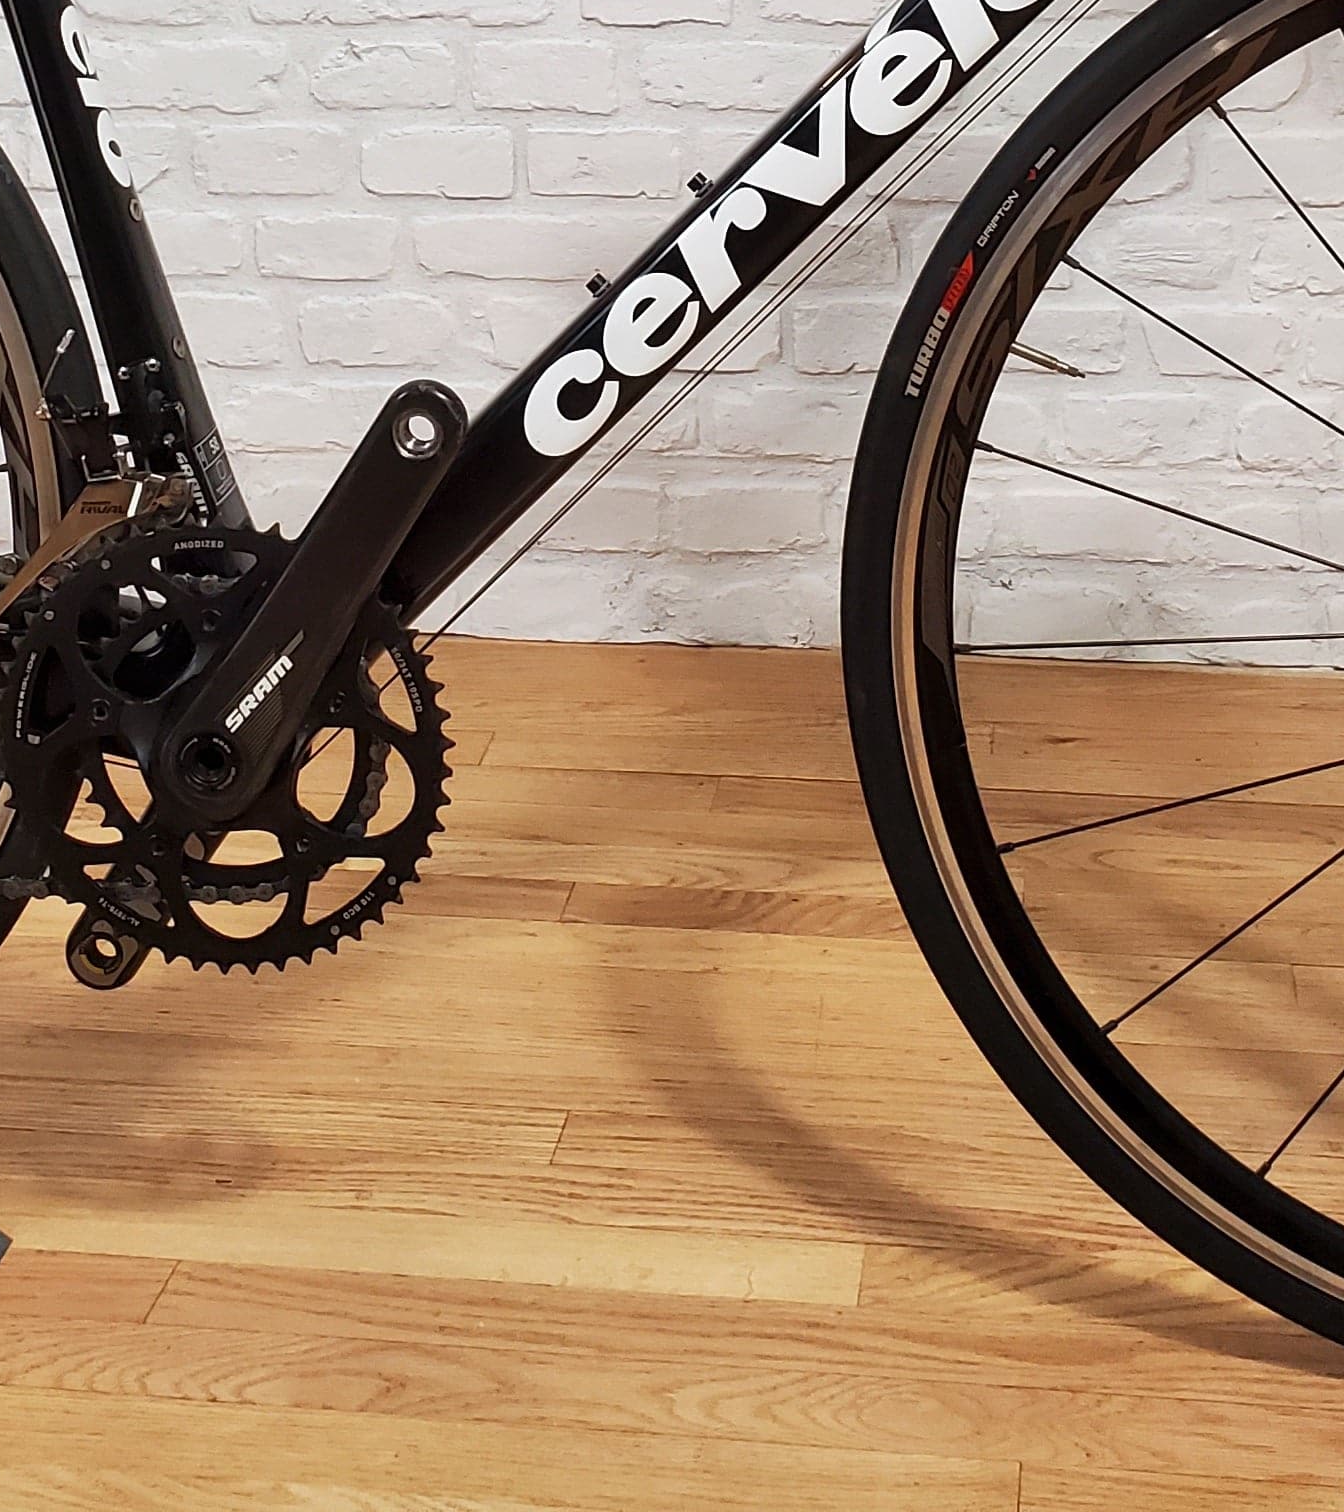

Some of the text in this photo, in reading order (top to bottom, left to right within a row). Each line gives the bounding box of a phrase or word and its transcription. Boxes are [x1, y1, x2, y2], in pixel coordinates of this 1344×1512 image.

[904, 307, 950, 398] TURBO
[174, 540, 224, 551] ANODIZED
[224, 654, 294, 734] SRAM
